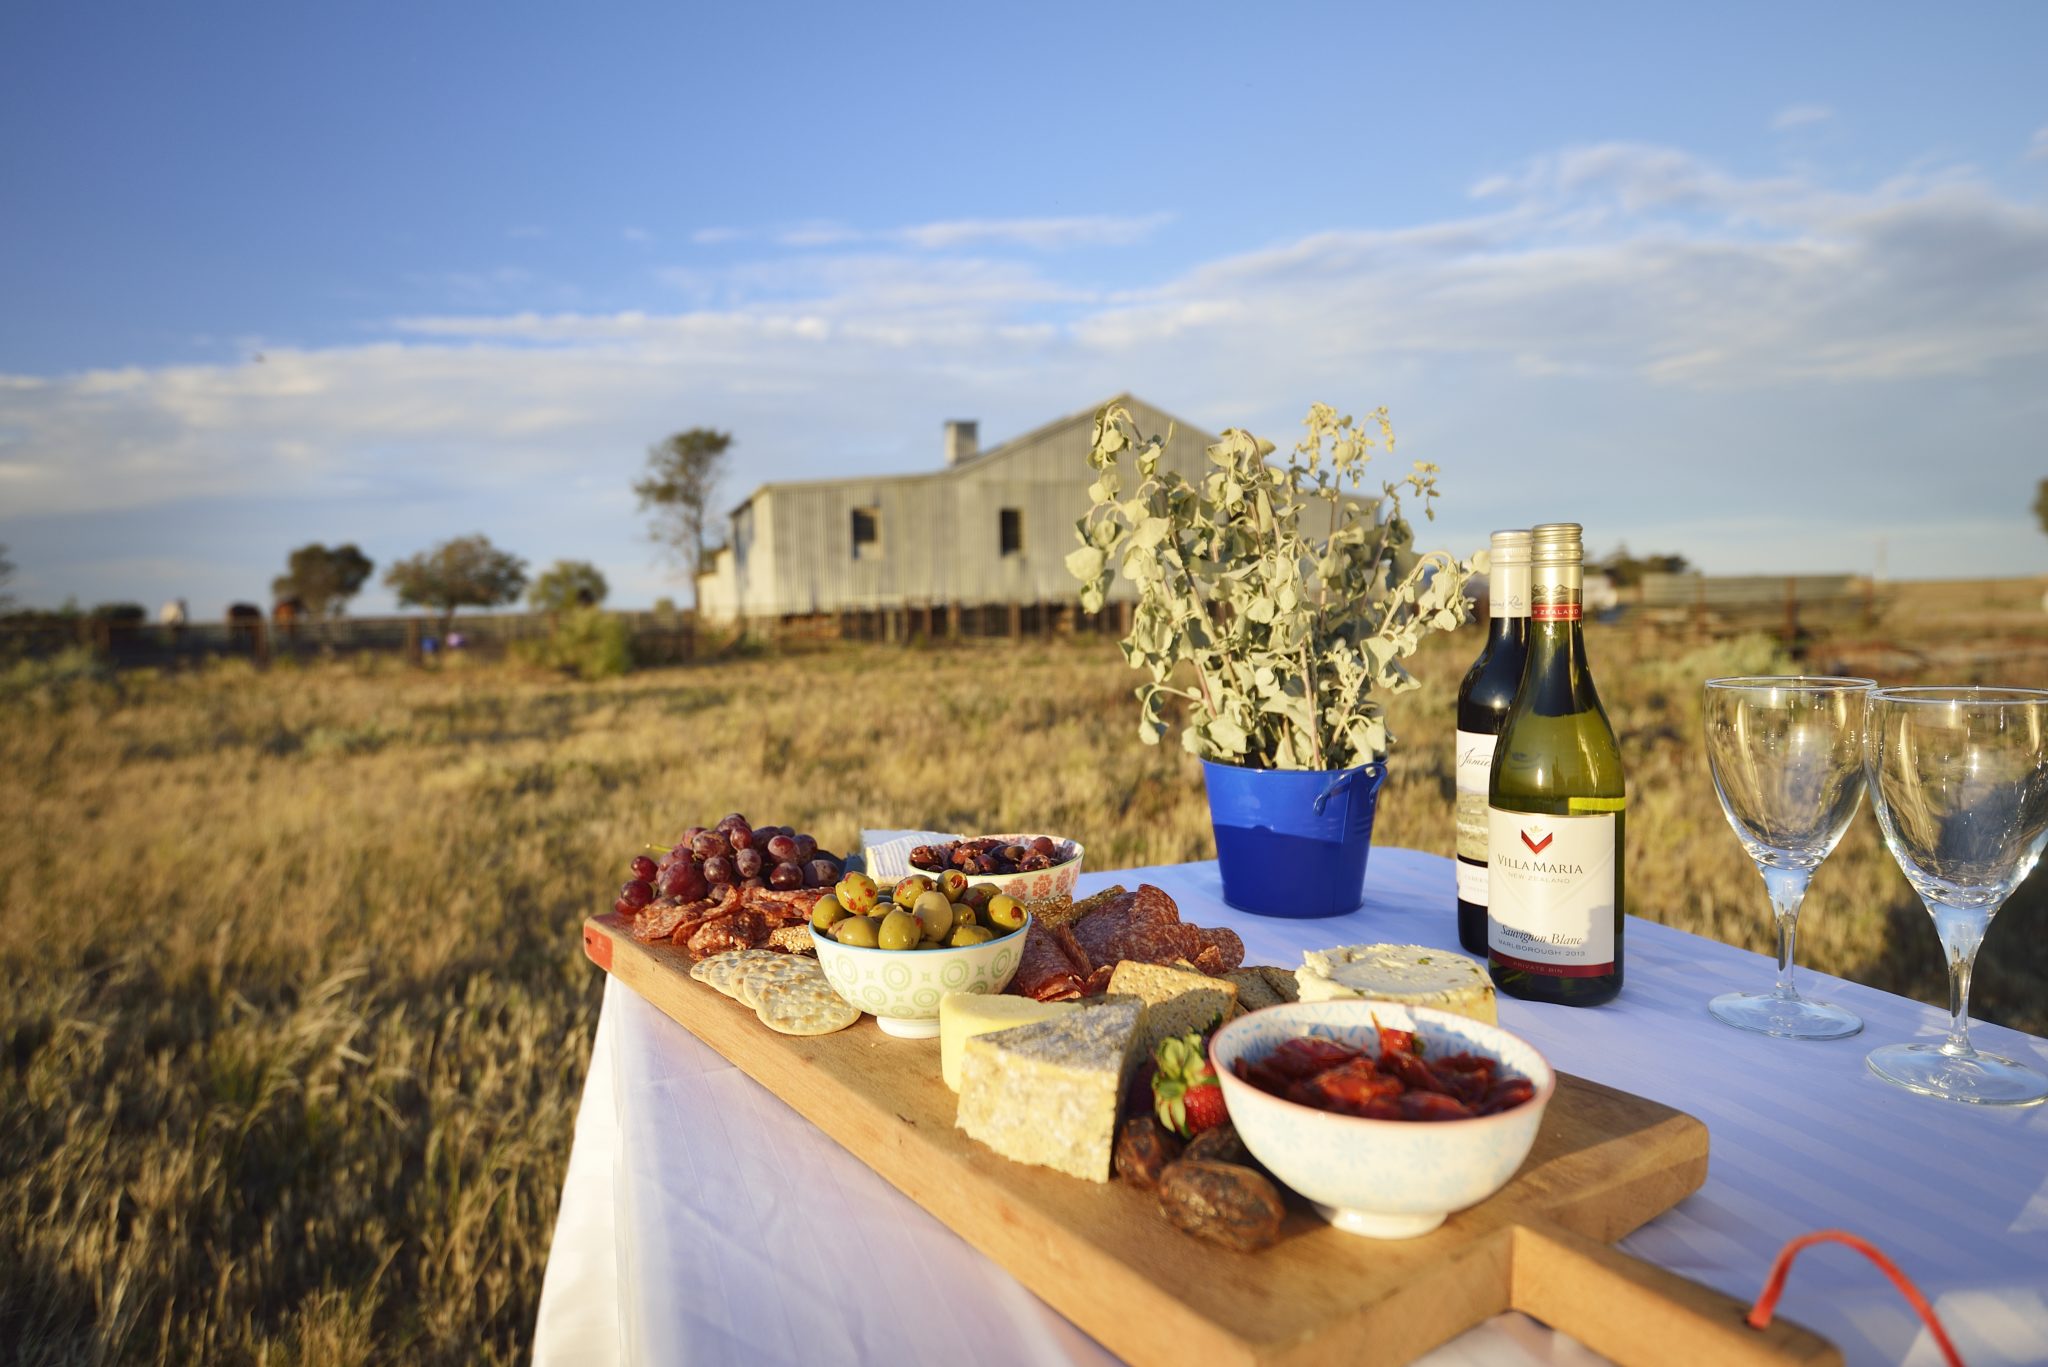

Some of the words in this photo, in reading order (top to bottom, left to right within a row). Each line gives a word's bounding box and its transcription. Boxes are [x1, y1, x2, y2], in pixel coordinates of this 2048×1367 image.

[1497, 853, 1529, 871] VILLA
[1533, 861, 1583, 874] MARIA
[1508, 871, 1525, 880] NEW
[1528, 875, 1570, 884] ZEALAND
[1500, 925, 1547, 944] Sauvignon
[1551, 933, 1582, 945] Blanc
[1498, 938, 1561, 956] MARLBOROUGH
[1513, 961, 1545, 973] PRIVATE
